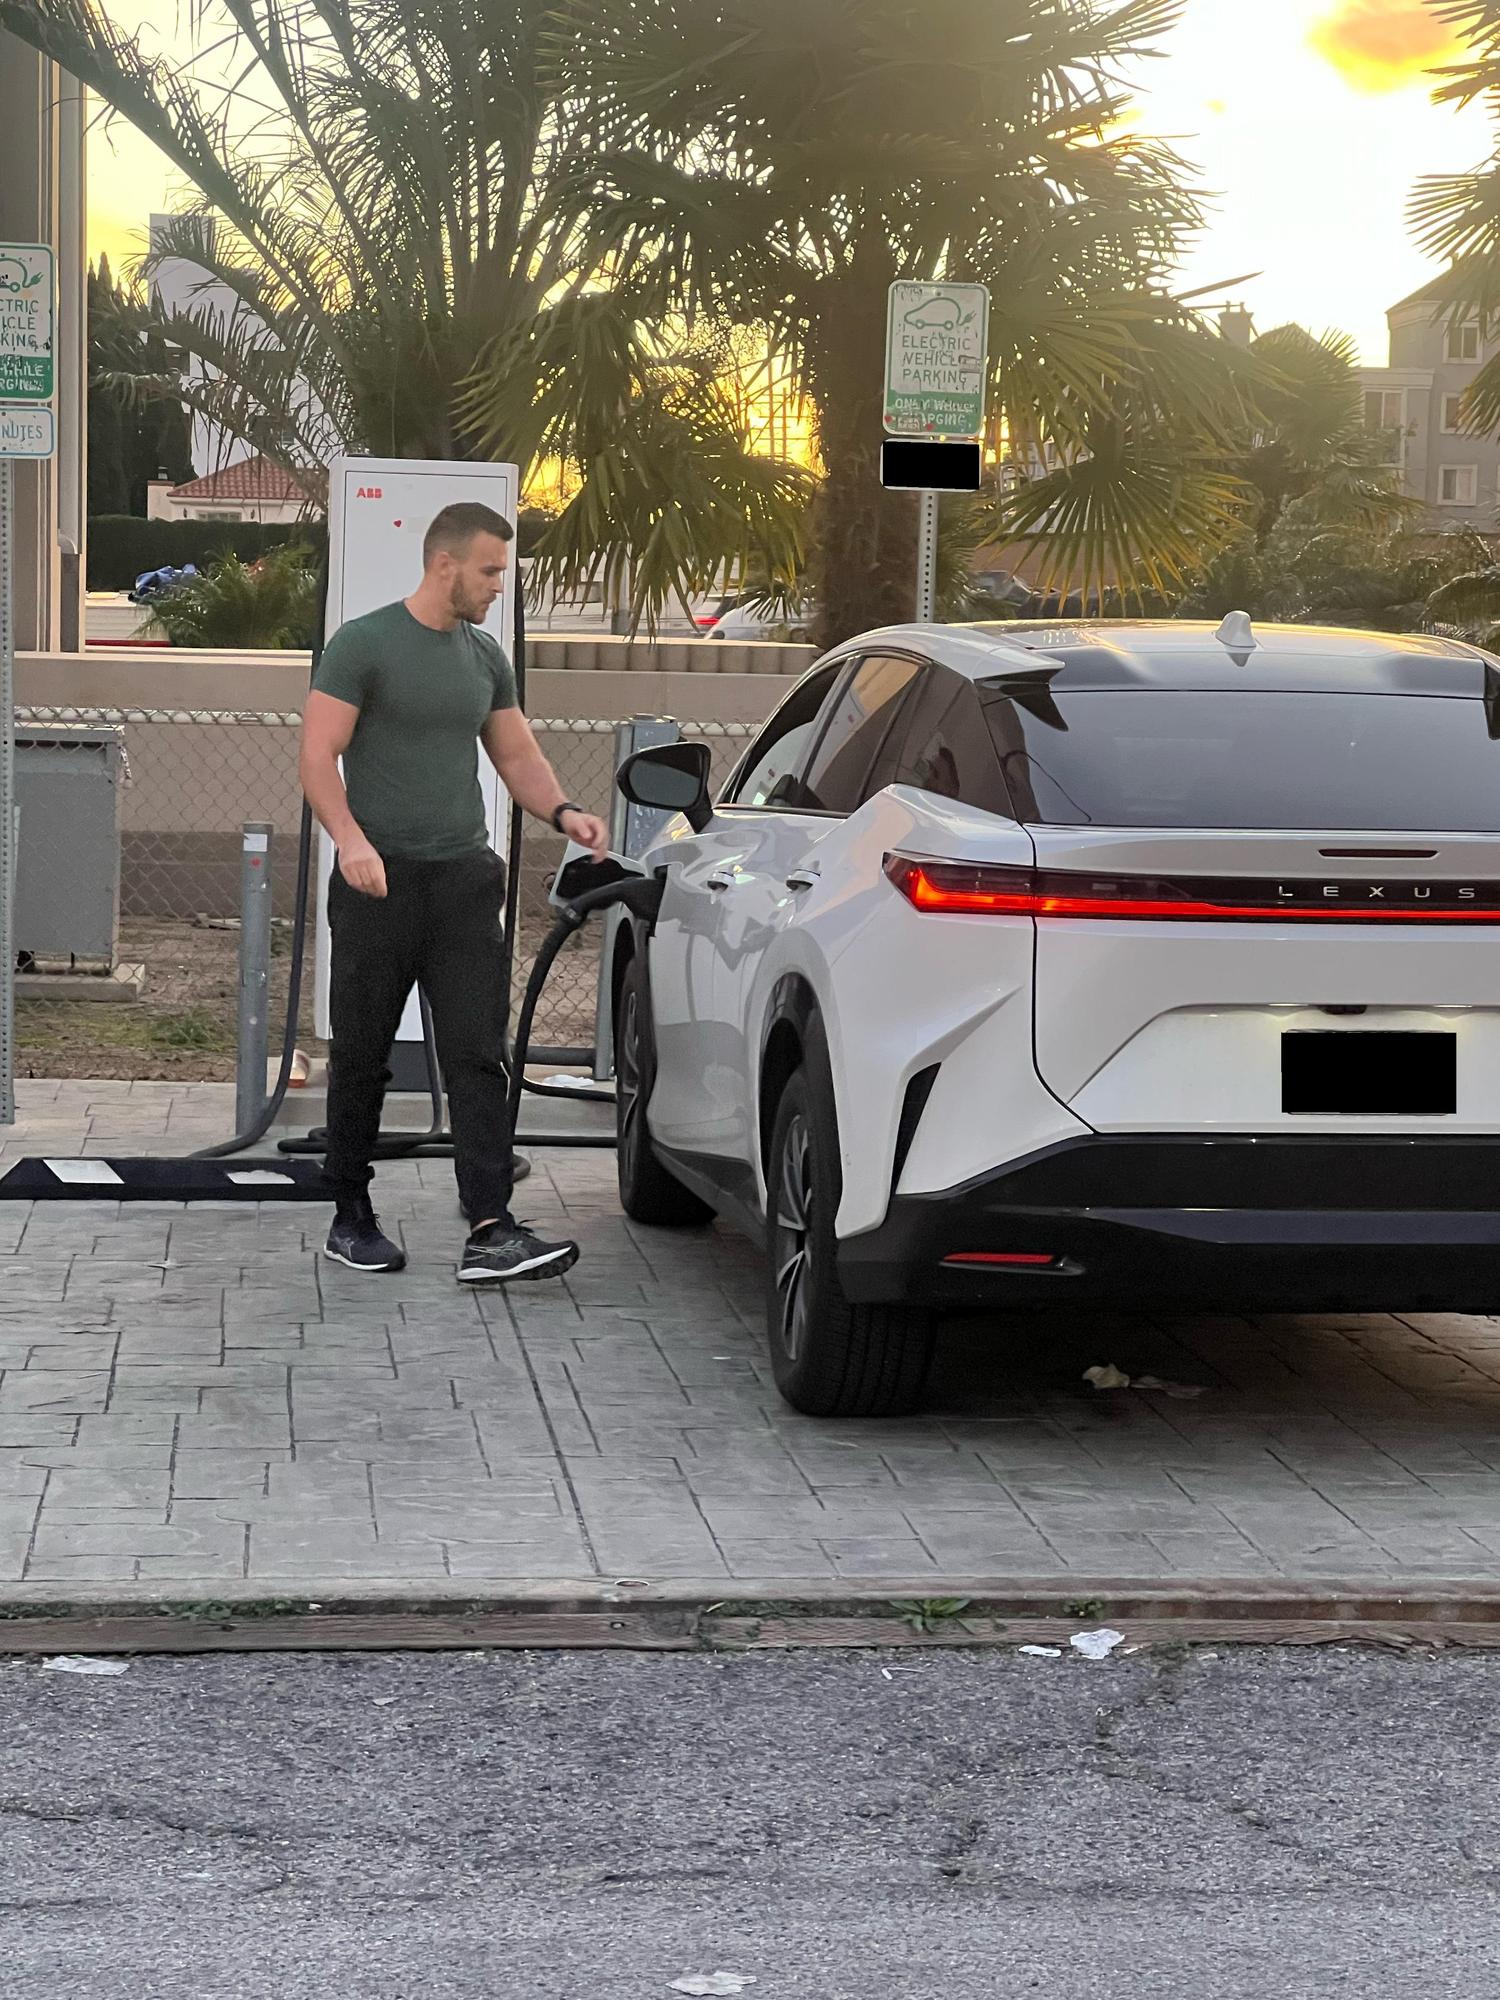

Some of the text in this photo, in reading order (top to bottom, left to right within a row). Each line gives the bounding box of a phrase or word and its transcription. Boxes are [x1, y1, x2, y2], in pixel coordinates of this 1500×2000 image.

[902, 335, 971, 350] ELECTRIC
[902, 351, 967, 367] VEHICL
[903, 368, 967, 385] PARKING
[356, 488, 382, 499] ABB
[1278, 885, 1475, 899] LEXUS
